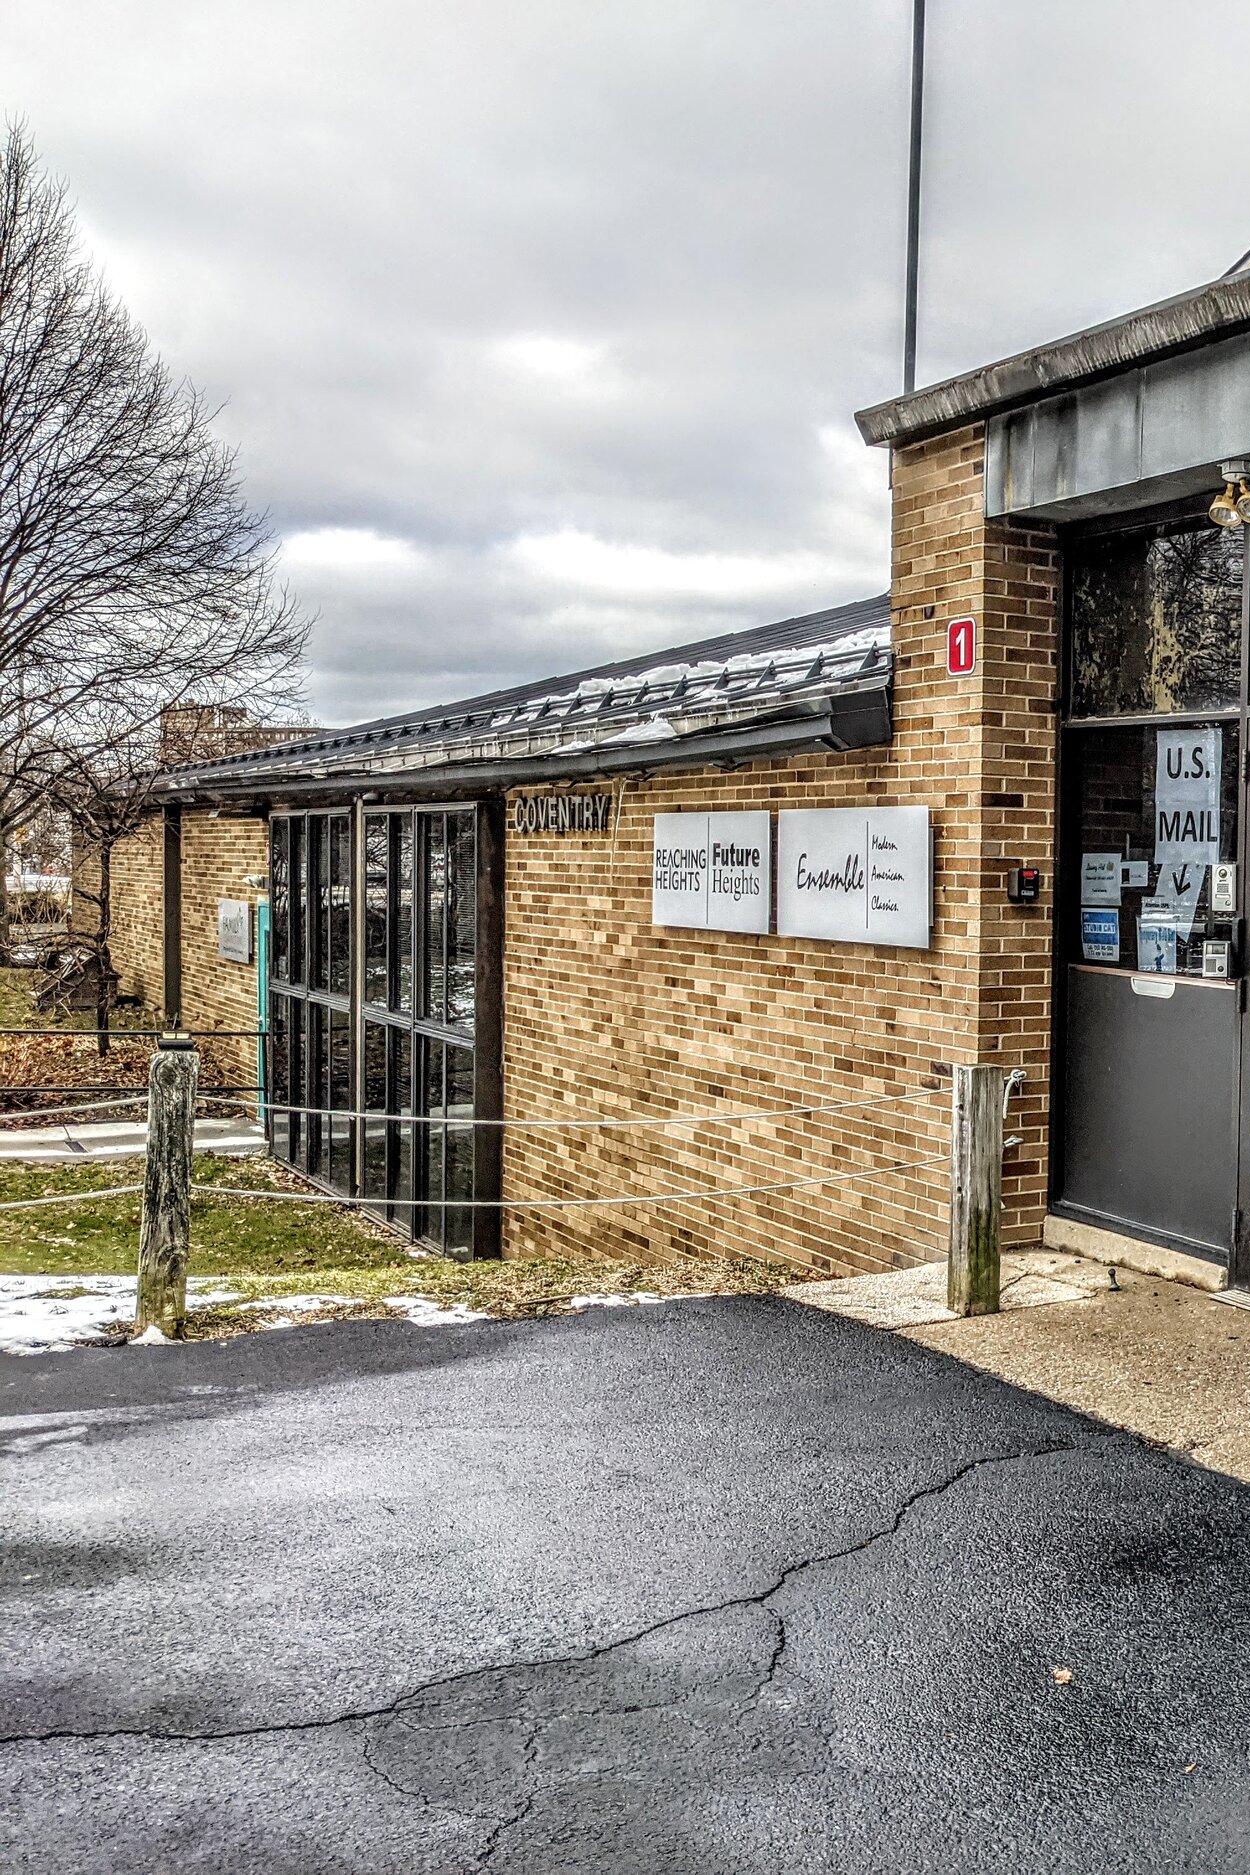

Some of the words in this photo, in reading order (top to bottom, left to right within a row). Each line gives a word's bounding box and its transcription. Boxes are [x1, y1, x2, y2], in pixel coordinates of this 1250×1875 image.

[955, 627, 966, 666] 1
[1166, 746, 1211, 780] U.S.
[514, 795, 607, 833] COVENTRY
[1159, 810, 1218, 843] MAIL
[712, 842, 761, 867] Future
[871, 834, 898, 850] Modern
[655, 848, 707, 870] REACHING
[796, 852, 865, 893] Ensemble
[870, 864, 905, 881] American
[654, 866, 701, 892] HEIGHTS
[712, 868, 760, 901] Heights
[871, 895, 899, 912] Classics
